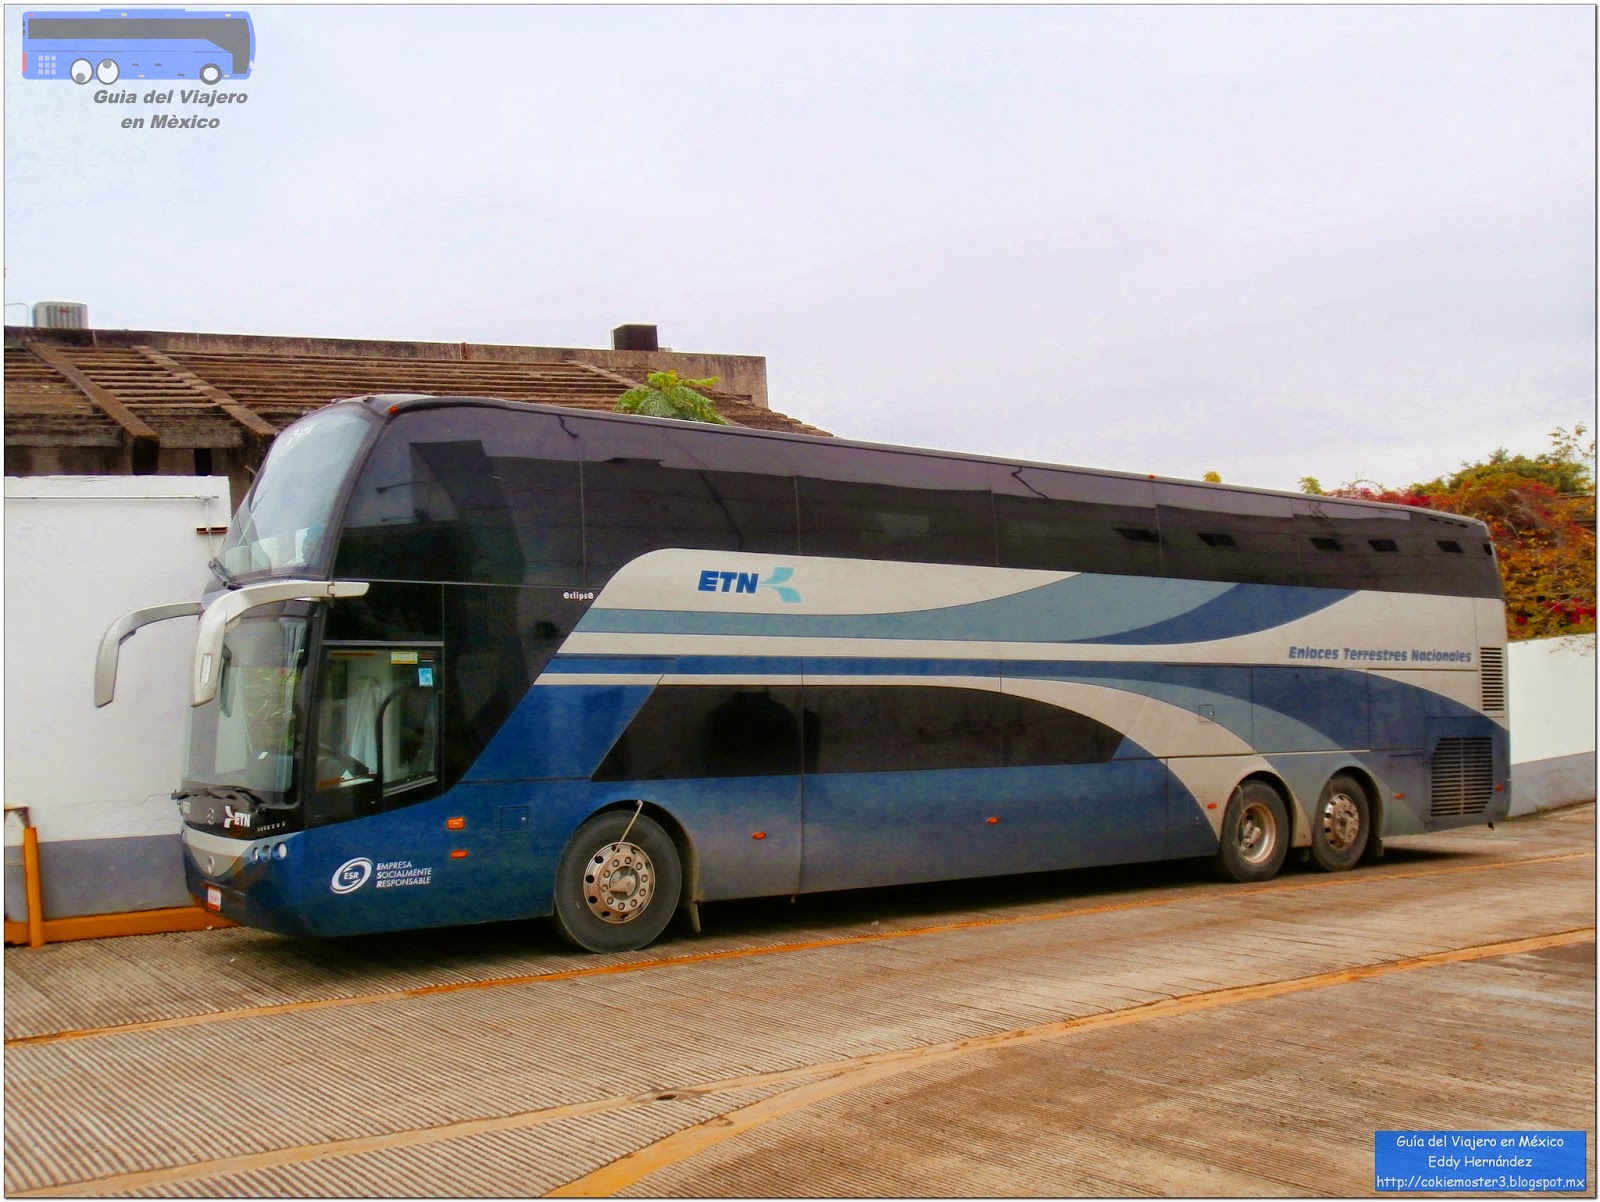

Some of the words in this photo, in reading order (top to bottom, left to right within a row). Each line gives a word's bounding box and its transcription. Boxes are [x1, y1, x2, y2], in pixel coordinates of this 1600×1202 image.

[697, 569, 759, 594] ETN
[563, 590, 594, 601] eclipse
[1288, 646, 1339, 660] Enlaces
[1343, 648, 1408, 662] Terrestres
[1411, 649, 1472, 663] Nacionales
[233, 811, 251, 828] ETN
[376, 860, 412, 871] EMPRESA
[343, 871, 360, 880] ESR
[376, 867, 432, 879] SOCIALMENTE
[376, 876, 431, 888] RESPONSABLE
